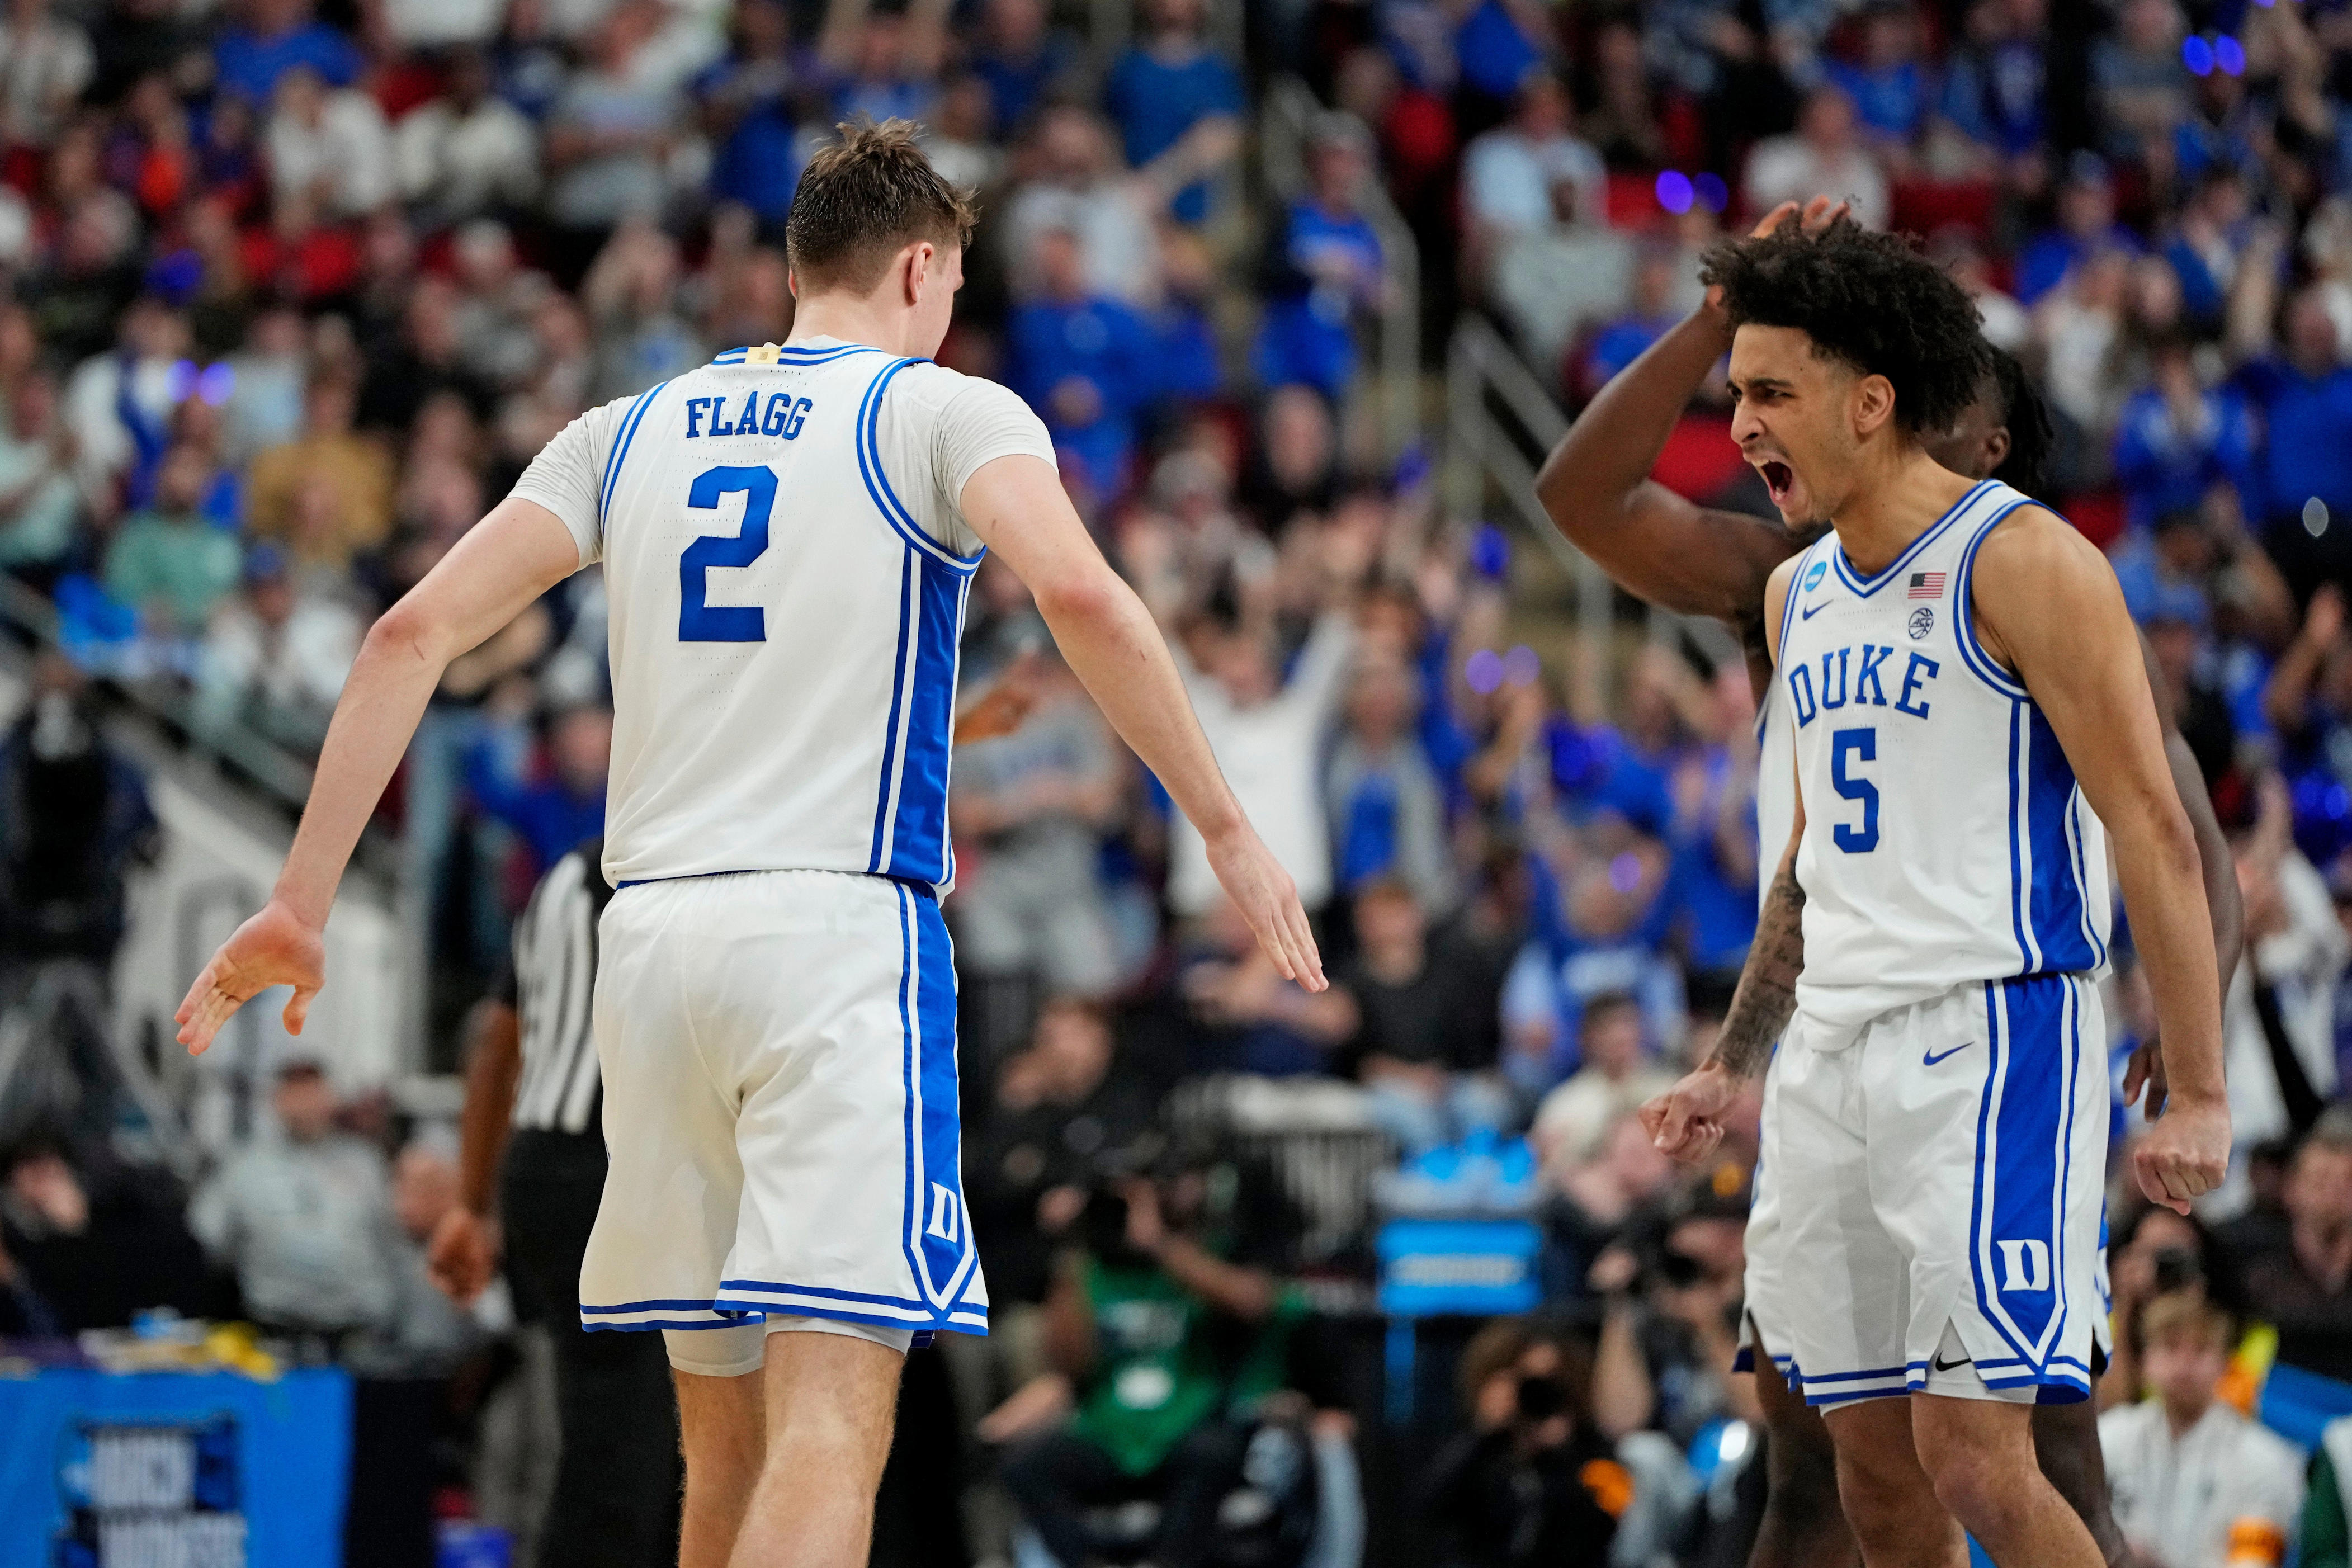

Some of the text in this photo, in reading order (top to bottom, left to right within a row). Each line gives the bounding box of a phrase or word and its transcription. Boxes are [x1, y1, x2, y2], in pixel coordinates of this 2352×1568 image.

[686, 391, 813, 441] FLAGG
[679, 465, 778, 642] 2
[1789, 644, 1940, 729] DUKE
[1831, 727, 1879, 853] 5
[925, 1181, 958, 1243] D
[1996, 1239, 2050, 1292] D
